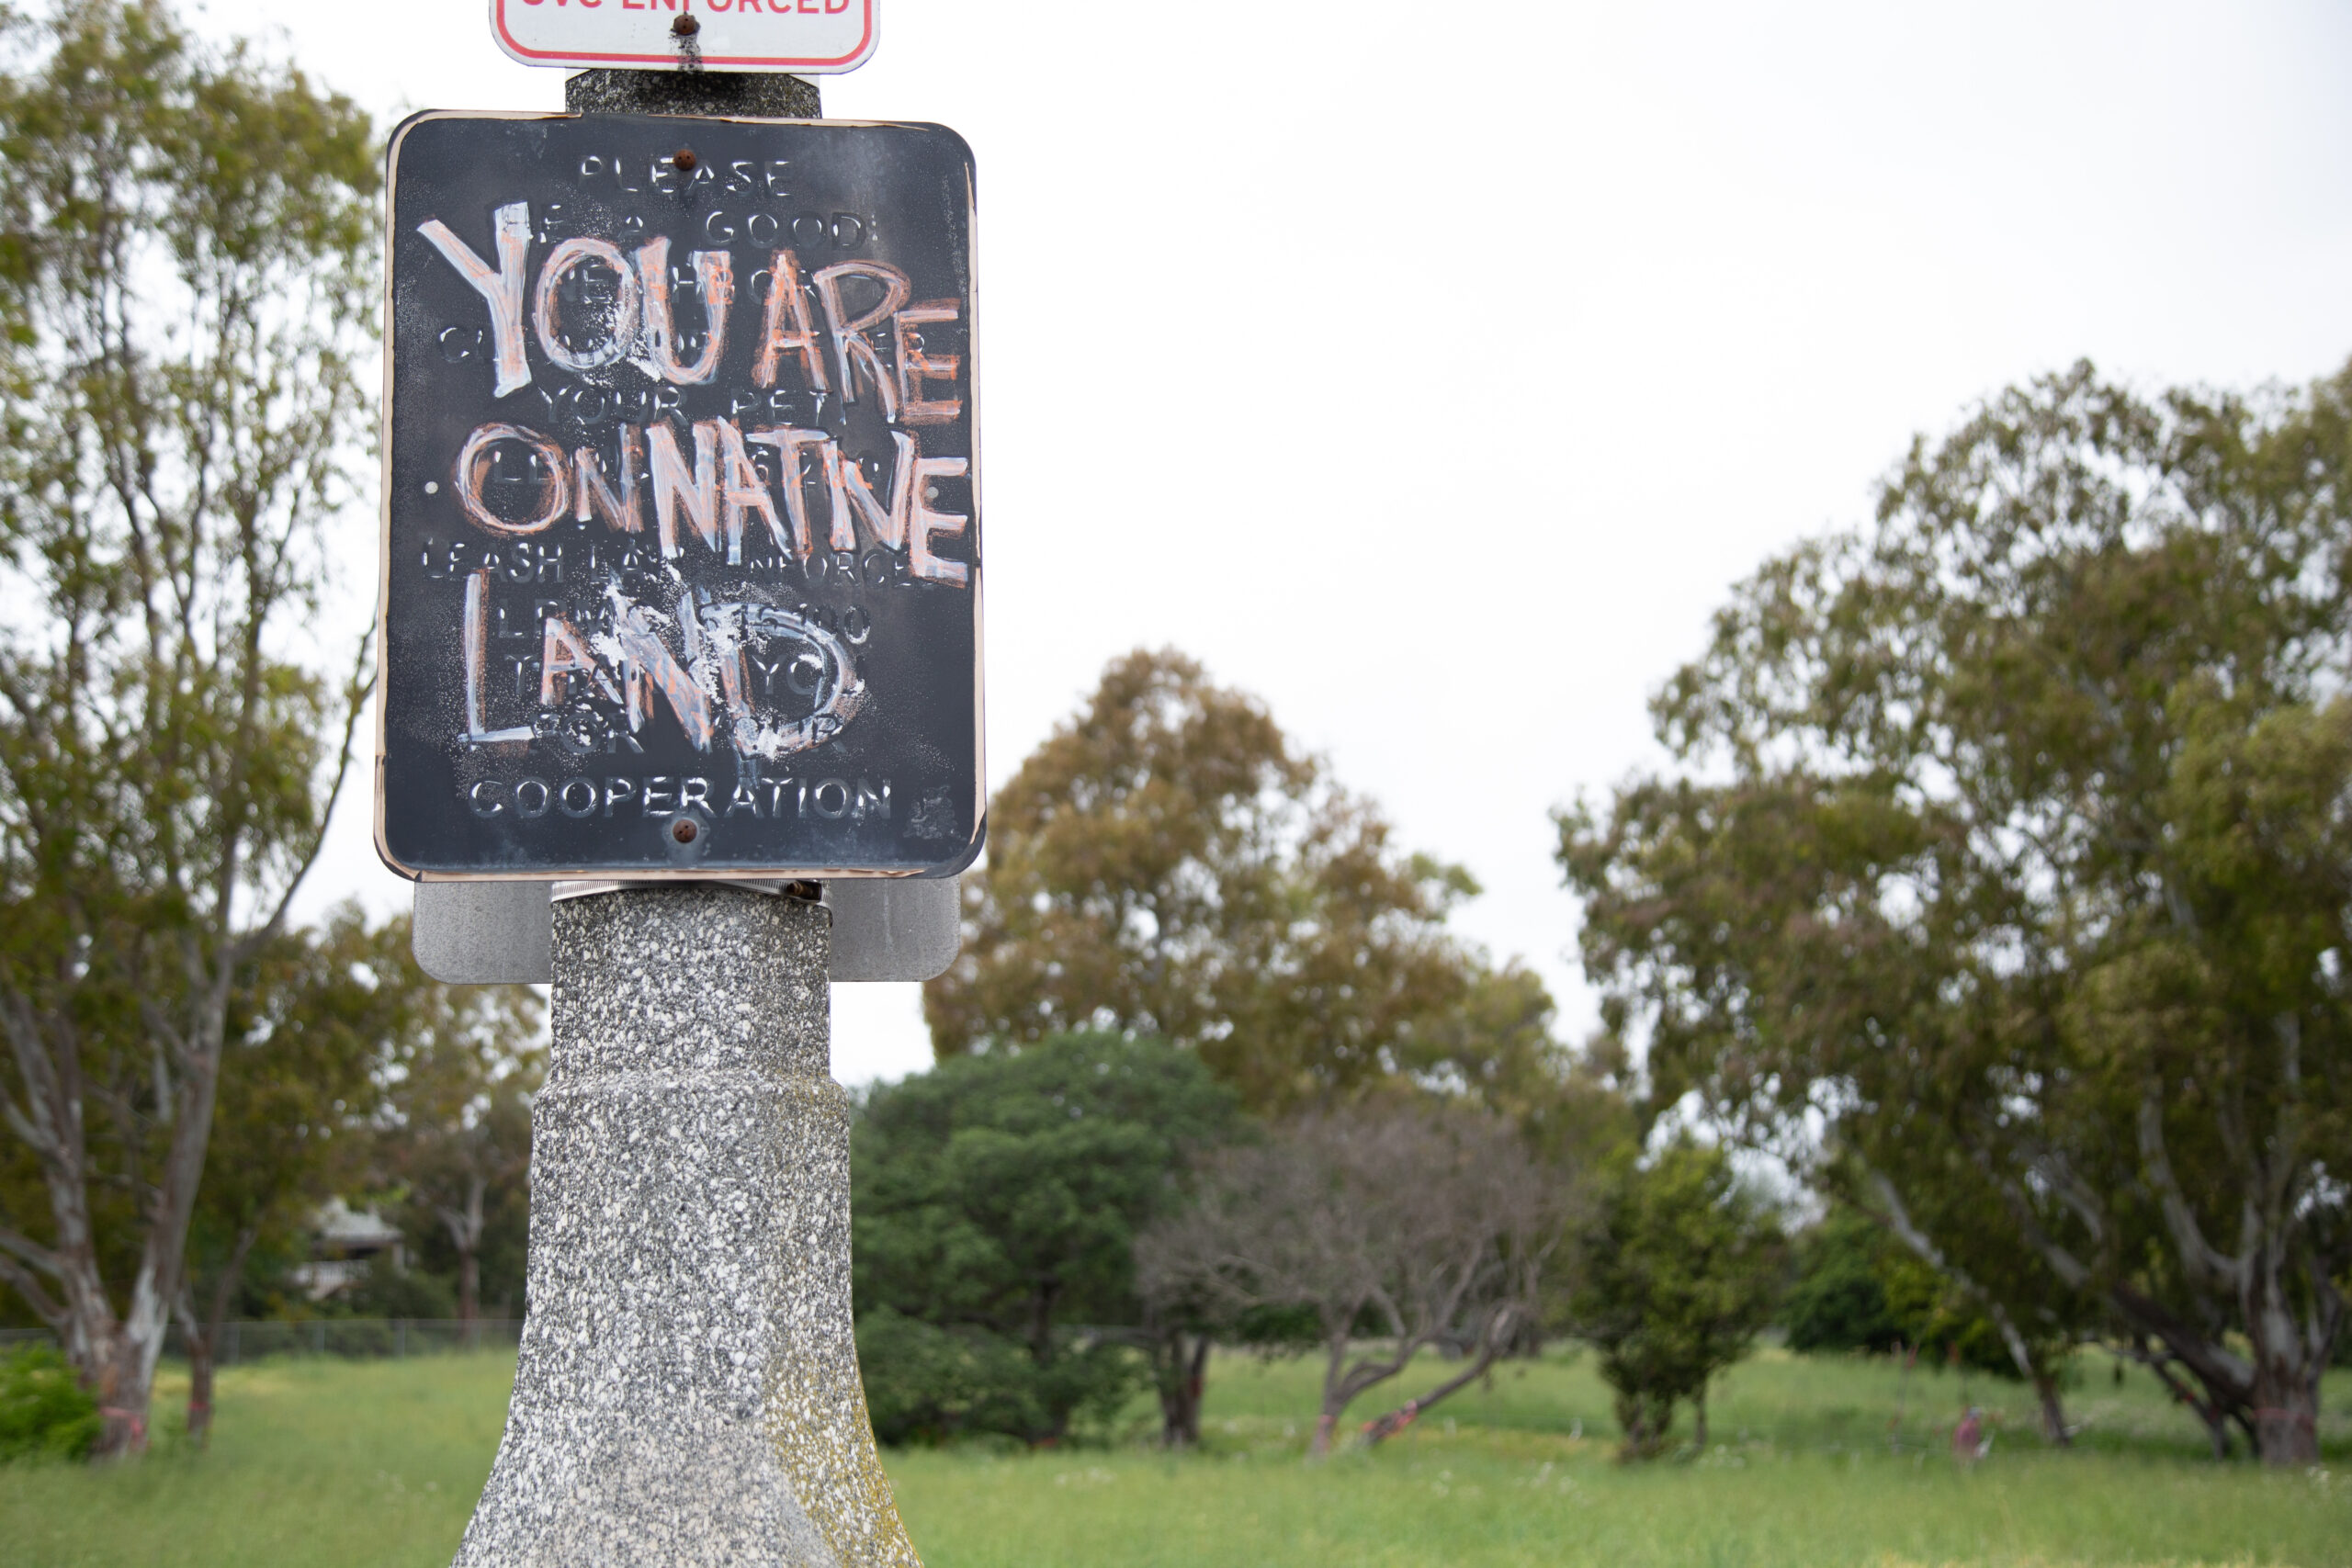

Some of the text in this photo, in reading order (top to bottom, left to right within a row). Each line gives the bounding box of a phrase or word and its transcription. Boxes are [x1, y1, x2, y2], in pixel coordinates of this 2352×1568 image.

[579, 154, 792, 197] PLEASE
[705, 210, 866, 250] GOOD
[416, 201, 963, 425] YOU ARE
[537, 384, 688, 426] YOUR
[452, 415, 970, 588] ON NATIVE
[422, 539, 946, 589] LEASH LA NFORCE
[456, 568, 862, 759] LAND
[469, 776, 892, 819] COOPERATION
